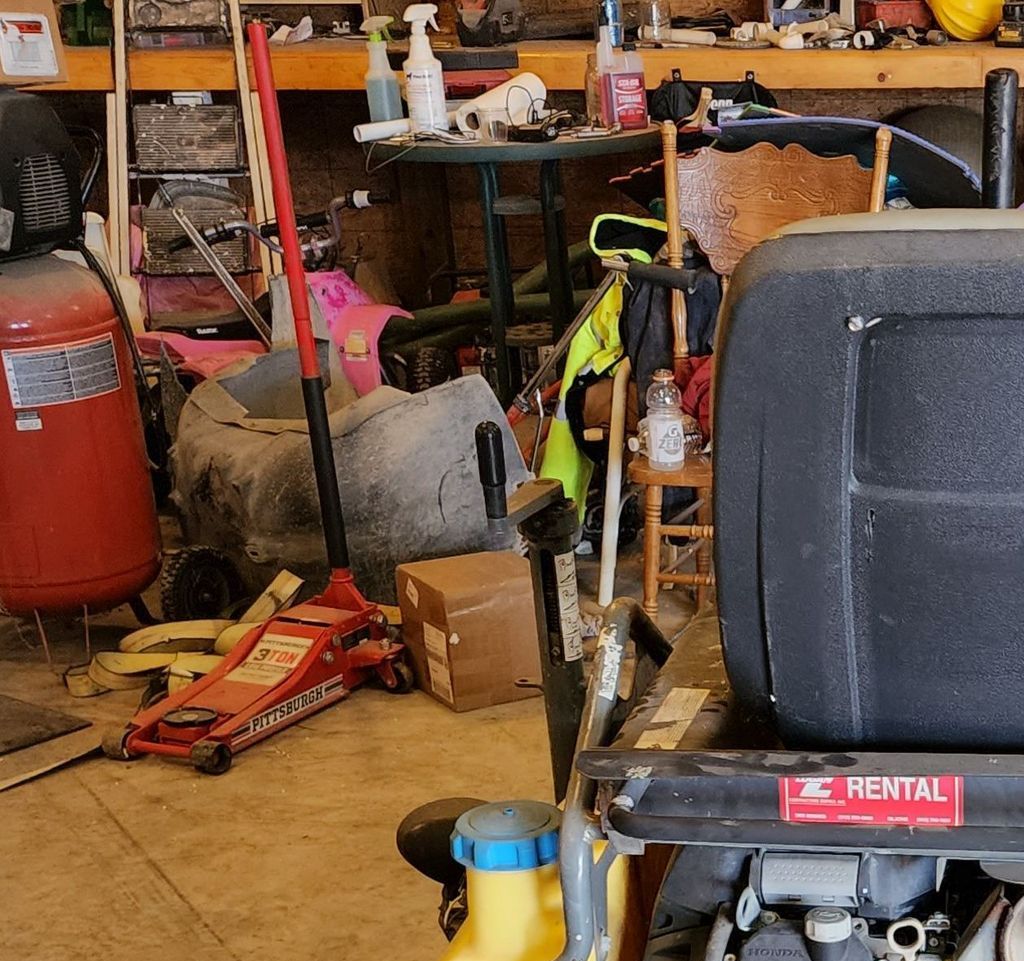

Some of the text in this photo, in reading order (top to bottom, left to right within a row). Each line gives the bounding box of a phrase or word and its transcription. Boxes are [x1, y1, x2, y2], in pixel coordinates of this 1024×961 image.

[269, 649, 300, 665] TON
[251, 685, 324, 733] PITTSBURGH
[847, 776, 948, 802] RENTAL
[747, 948, 804, 958] HONDA
